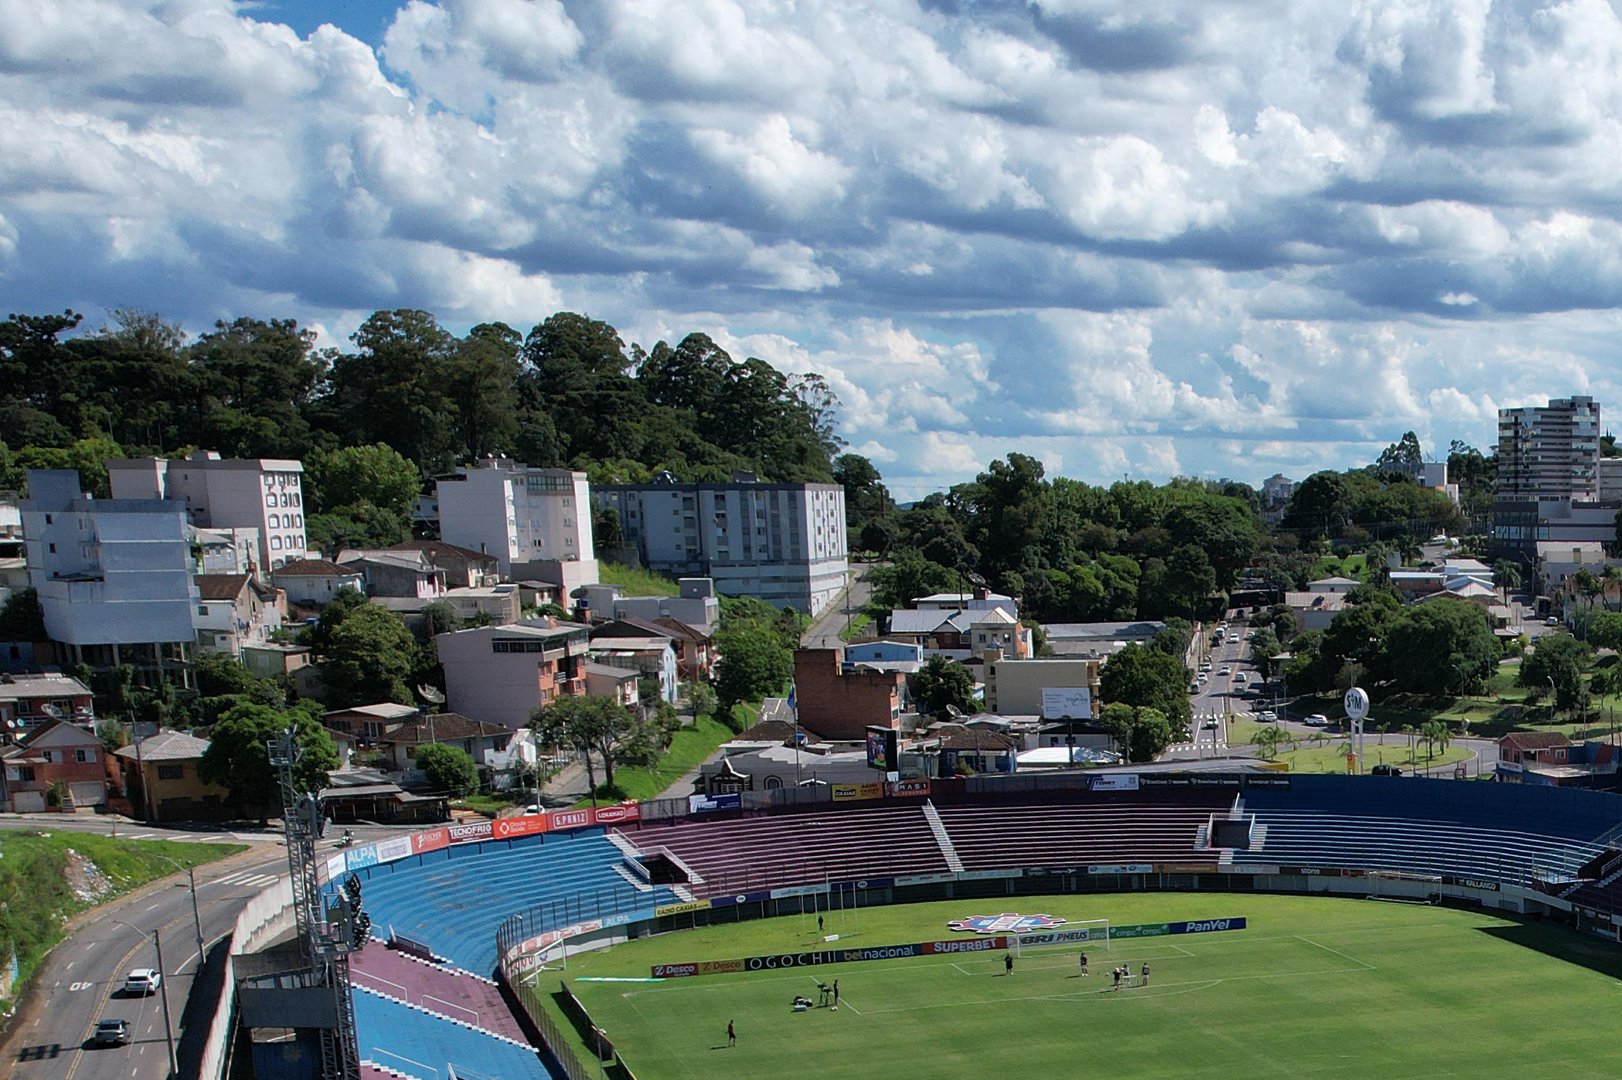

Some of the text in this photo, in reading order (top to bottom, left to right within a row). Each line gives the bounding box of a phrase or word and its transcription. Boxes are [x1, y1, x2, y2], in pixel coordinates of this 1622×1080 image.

[449, 824, 492, 837] TECNOFRIO
[346, 846, 376, 863] ALPA
[675, 903, 698, 913] CAXIAS
[606, 914, 630, 925] ALPA
[1186, 919, 1230, 932] PanVel
[1056, 931, 1088, 942] PNEUS
[1116, 929, 1136, 938] cmpc
[934, 938, 997, 953] SUPERBET
[843, 945, 915, 961] betnacional
[666, 965, 695, 974] Desco
[713, 961, 741, 970] Desco
